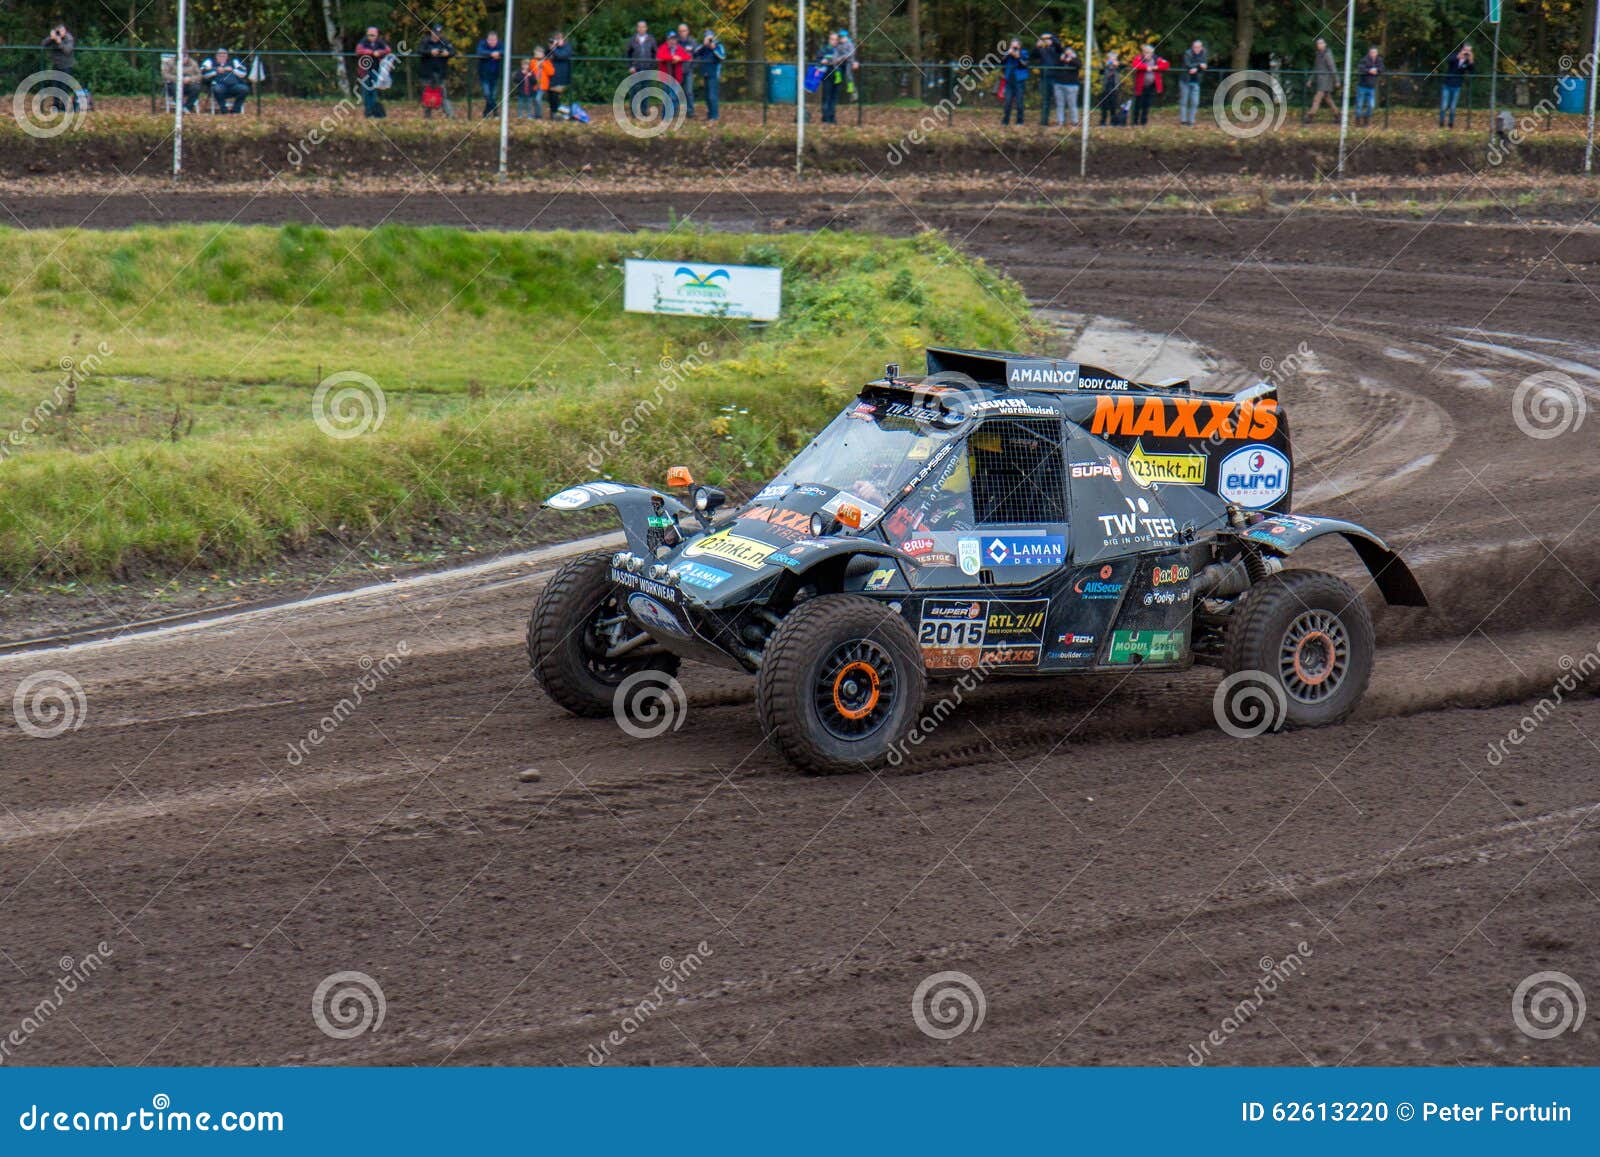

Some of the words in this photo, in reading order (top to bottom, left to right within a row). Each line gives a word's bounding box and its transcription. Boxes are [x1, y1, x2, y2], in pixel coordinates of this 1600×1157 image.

[1010, 369, 1076, 384] AMANDO
[1079, 377, 1103, 389] BODY
[1104, 379, 1129, 390] CARE
[969, 398, 1027, 412] KEUKEN
[1090, 395, 1278, 440] MAXXIS
[1227, 468, 1283, 490] eurol
[1098, 512, 1136, 536] TW
[1121, 537, 1131, 545] IN
[1012, 543, 1062, 555] LAMAN
[1014, 557, 1062, 565] DEXIS
[639, 578, 676, 602] WORKWEAR
[931, 607, 968, 616] SUPER
[989, 614, 1014, 628] RTL
[919, 621, 984, 645] 2015
